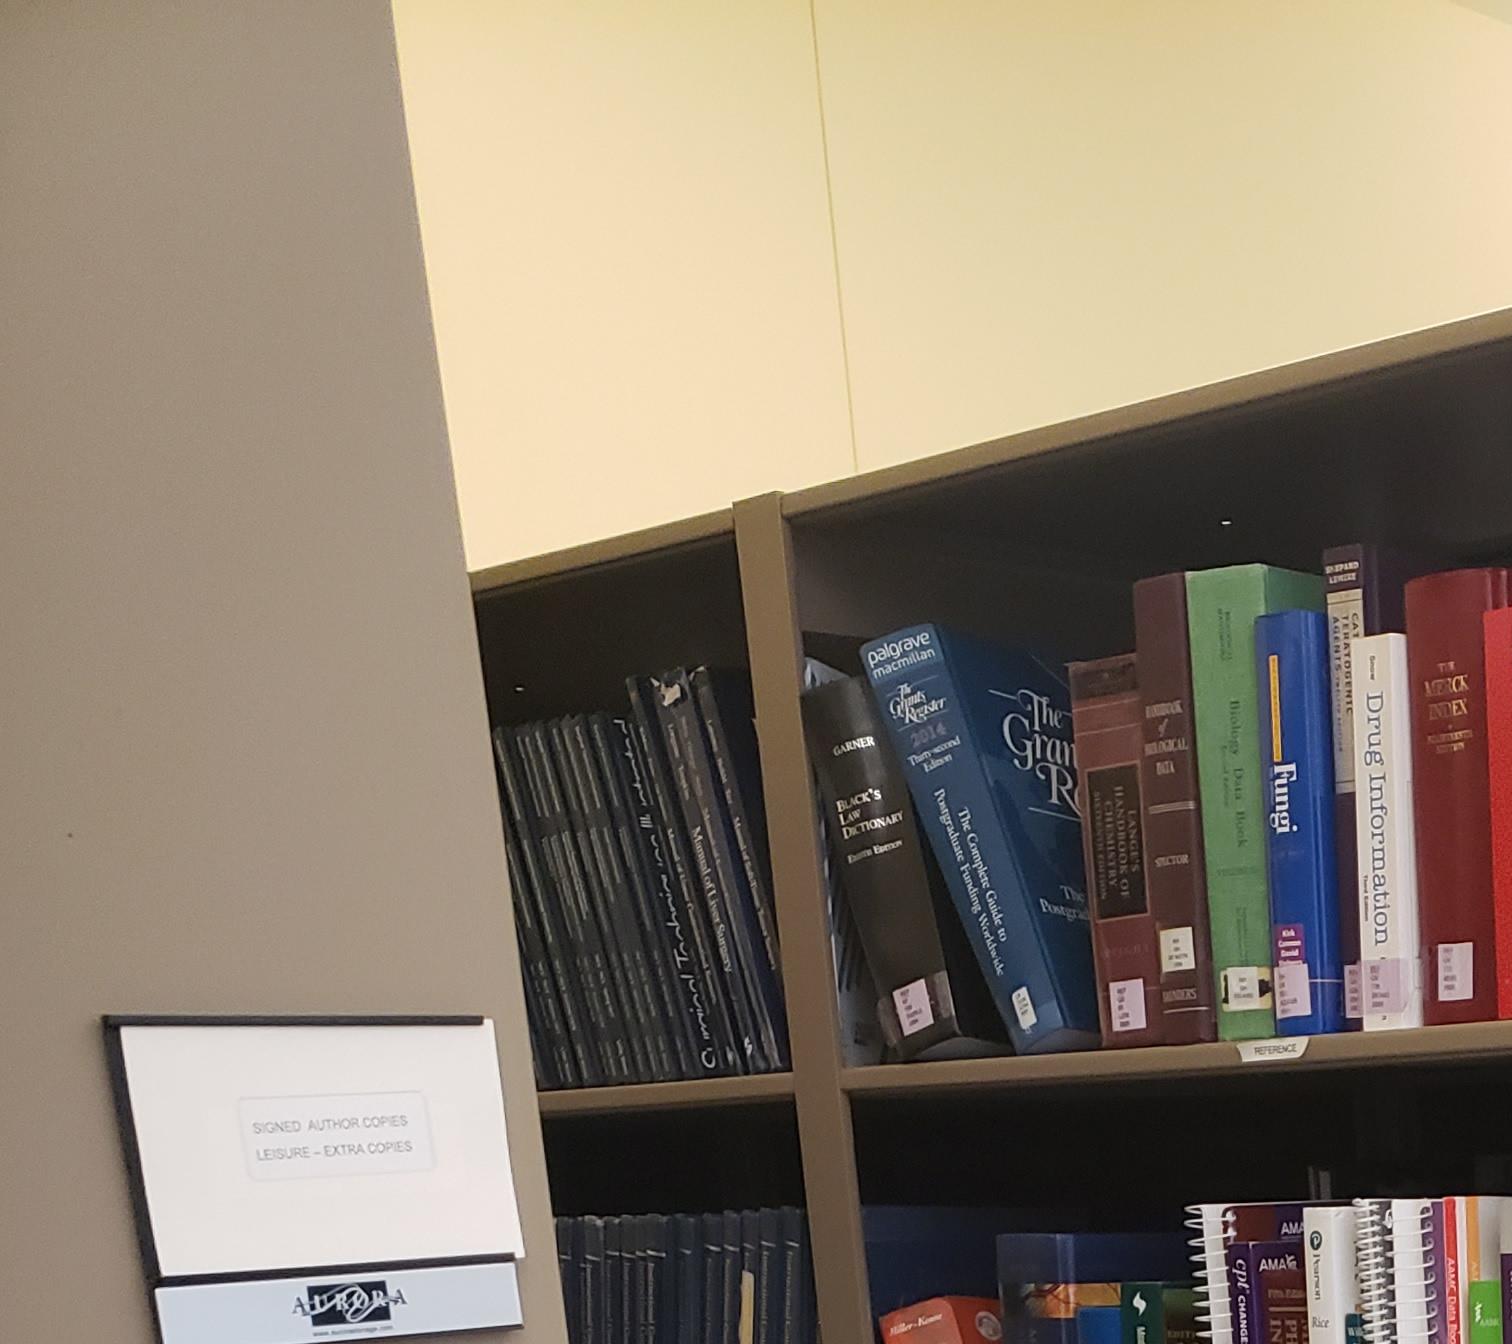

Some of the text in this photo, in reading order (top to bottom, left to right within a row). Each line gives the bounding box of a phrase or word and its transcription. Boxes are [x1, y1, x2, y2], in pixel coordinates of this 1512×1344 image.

[867, 631, 930, 668] palgrave
[1332, 616, 1342, 674] AGENTS
[872, 648, 936, 680] macmillan
[1424, 674, 1470, 697] MERCK
[904, 697, 947, 724] Register
[1017, 689, 1064, 731] The
[1429, 698, 1468, 720] INDEX
[832, 735, 876, 756] GARNER
[910, 722, 947, 747] 2014
[923, 753, 953, 773] Edition
[1229, 700, 1248, 848] Biology Data Book
[835, 788, 882, 812] BLACK'S
[1270, 762, 1298, 834] Fungi
[1364, 655, 1389, 946] Snow Drug Information
[839, 809, 861, 826] LAW
[842, 810, 904, 839] DICTIONARY
[1114, 786, 1129, 876] HANDBOOK
[1105, 800, 1118, 887] CHEMISTRY
[934, 788, 1005, 977] Postgraduate Funding Worldwide
[957, 806, 1008, 942] The Complete Guide to
[252, 1115, 408, 1134] SIGNED AUTHOR COPIES
[256, 1140, 413, 1161] LEISURE EXTRA COPIES
[1232, 1258, 1249, 1292] cpt
[1259, 1259, 1288, 1272] AMA
[291, 1284, 408, 1320] AURORA
[1312, 1317, 1330, 1329] Rice
